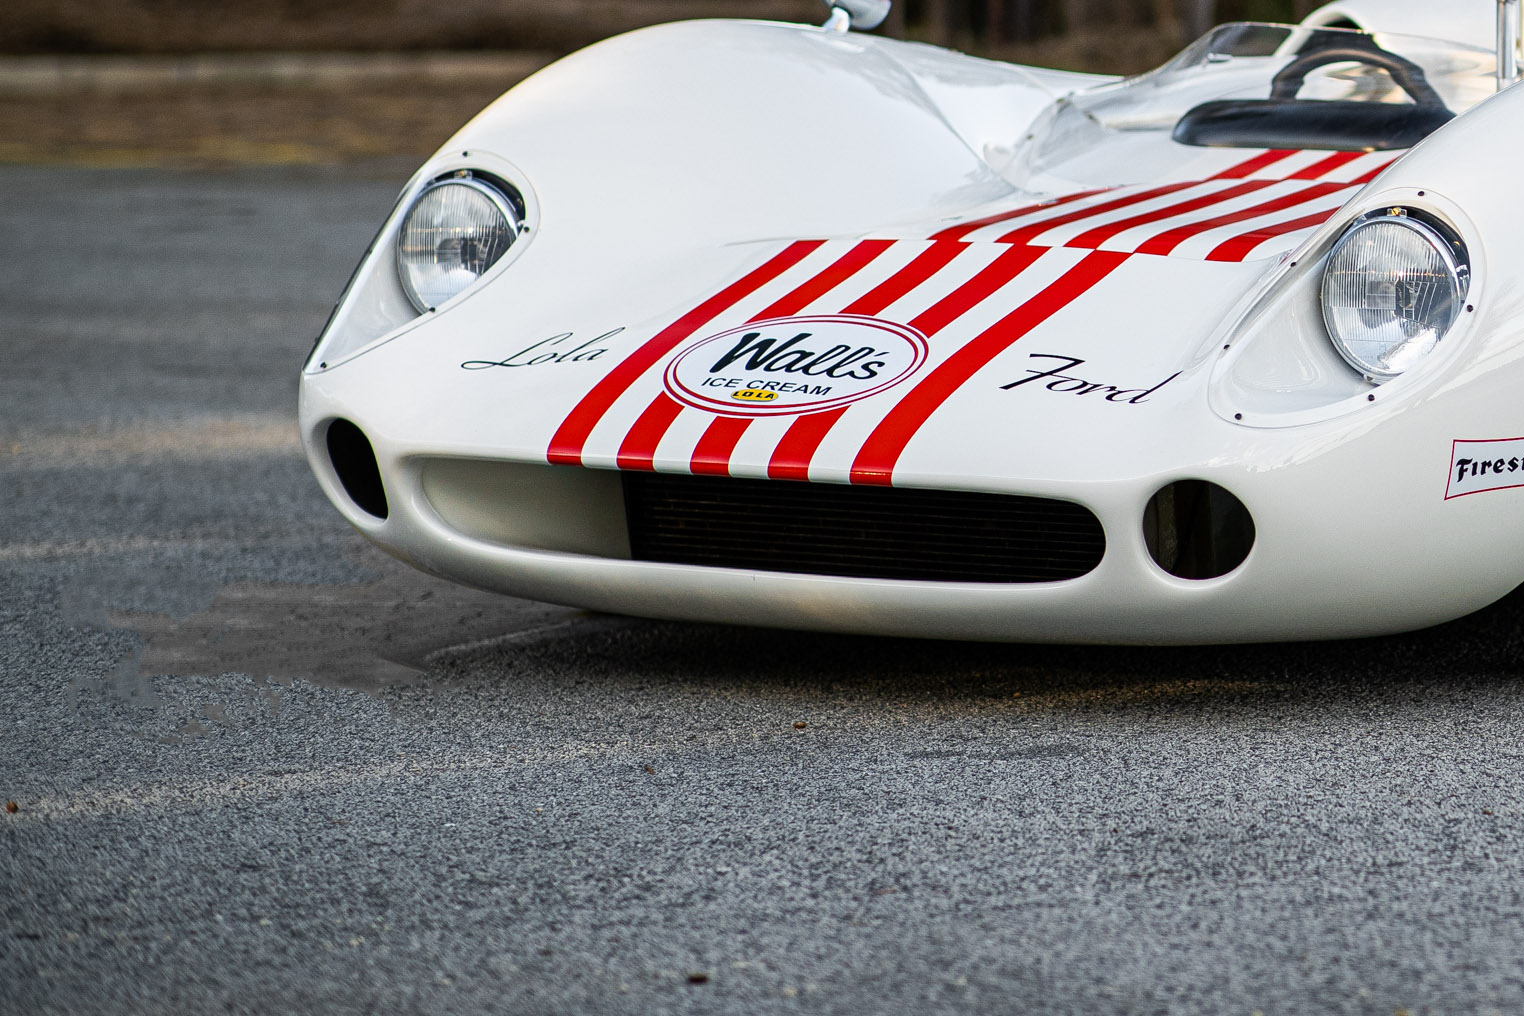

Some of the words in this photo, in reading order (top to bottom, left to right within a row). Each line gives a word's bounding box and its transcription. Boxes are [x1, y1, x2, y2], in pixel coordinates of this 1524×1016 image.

[460, 326, 626, 371] Lola
[708, 332, 890, 380] Wall's
[701, 377, 744, 389] ICE
[746, 377, 833, 396] CREAM
[732, 390, 776, 400] LOLA
[998, 353, 1185, 405] Ford
